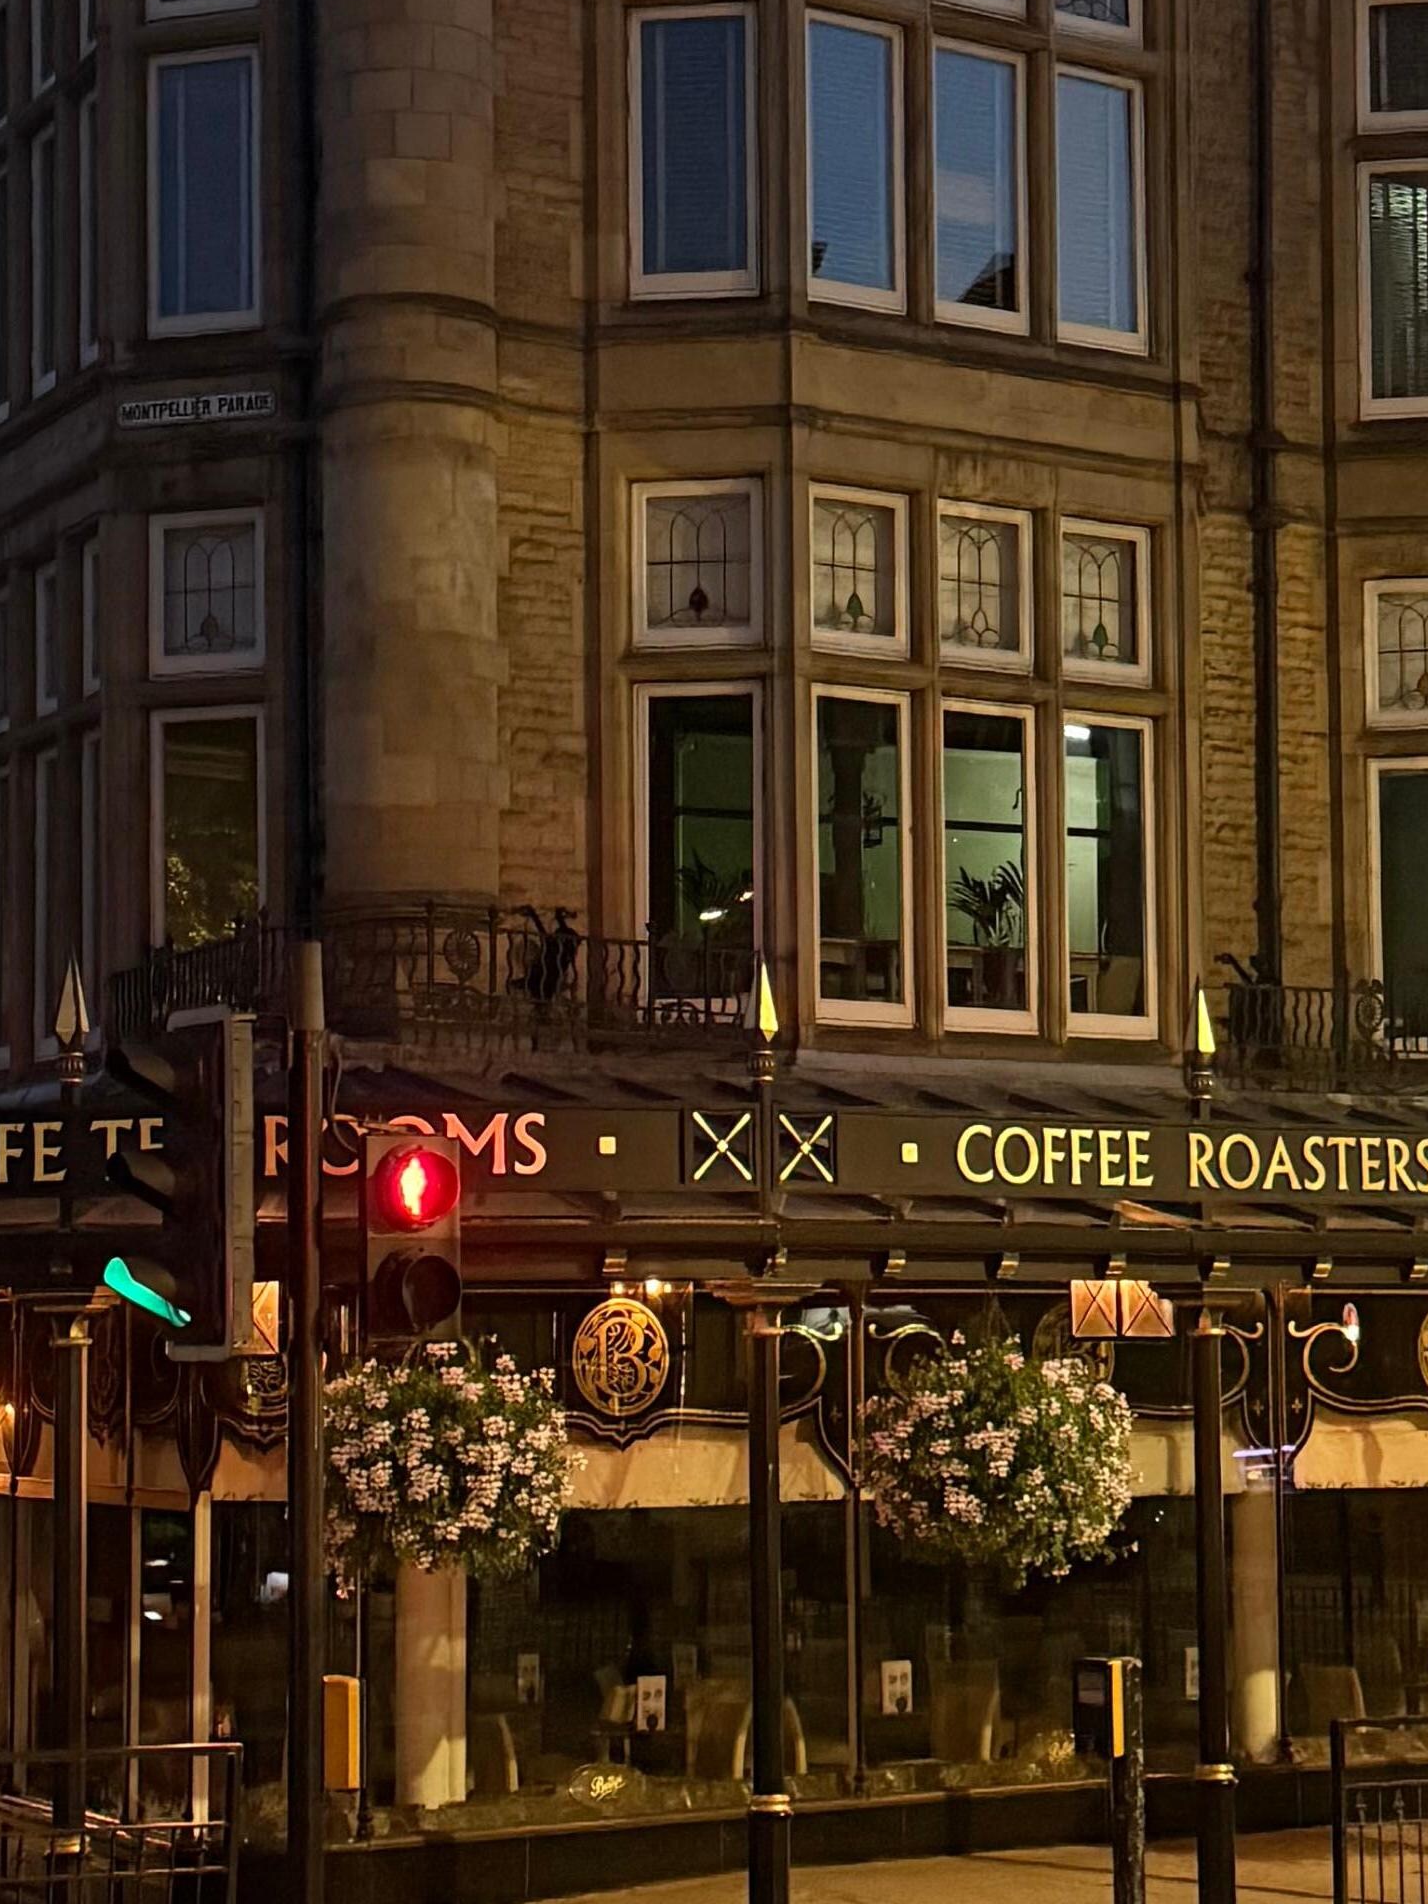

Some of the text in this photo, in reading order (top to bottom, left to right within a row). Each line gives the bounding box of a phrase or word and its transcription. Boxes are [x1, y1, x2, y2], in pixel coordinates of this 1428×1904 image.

[121, 393, 273, 422] MONTPELLIER PARADE
[955, 1123, 1155, 1188] COFFEE
